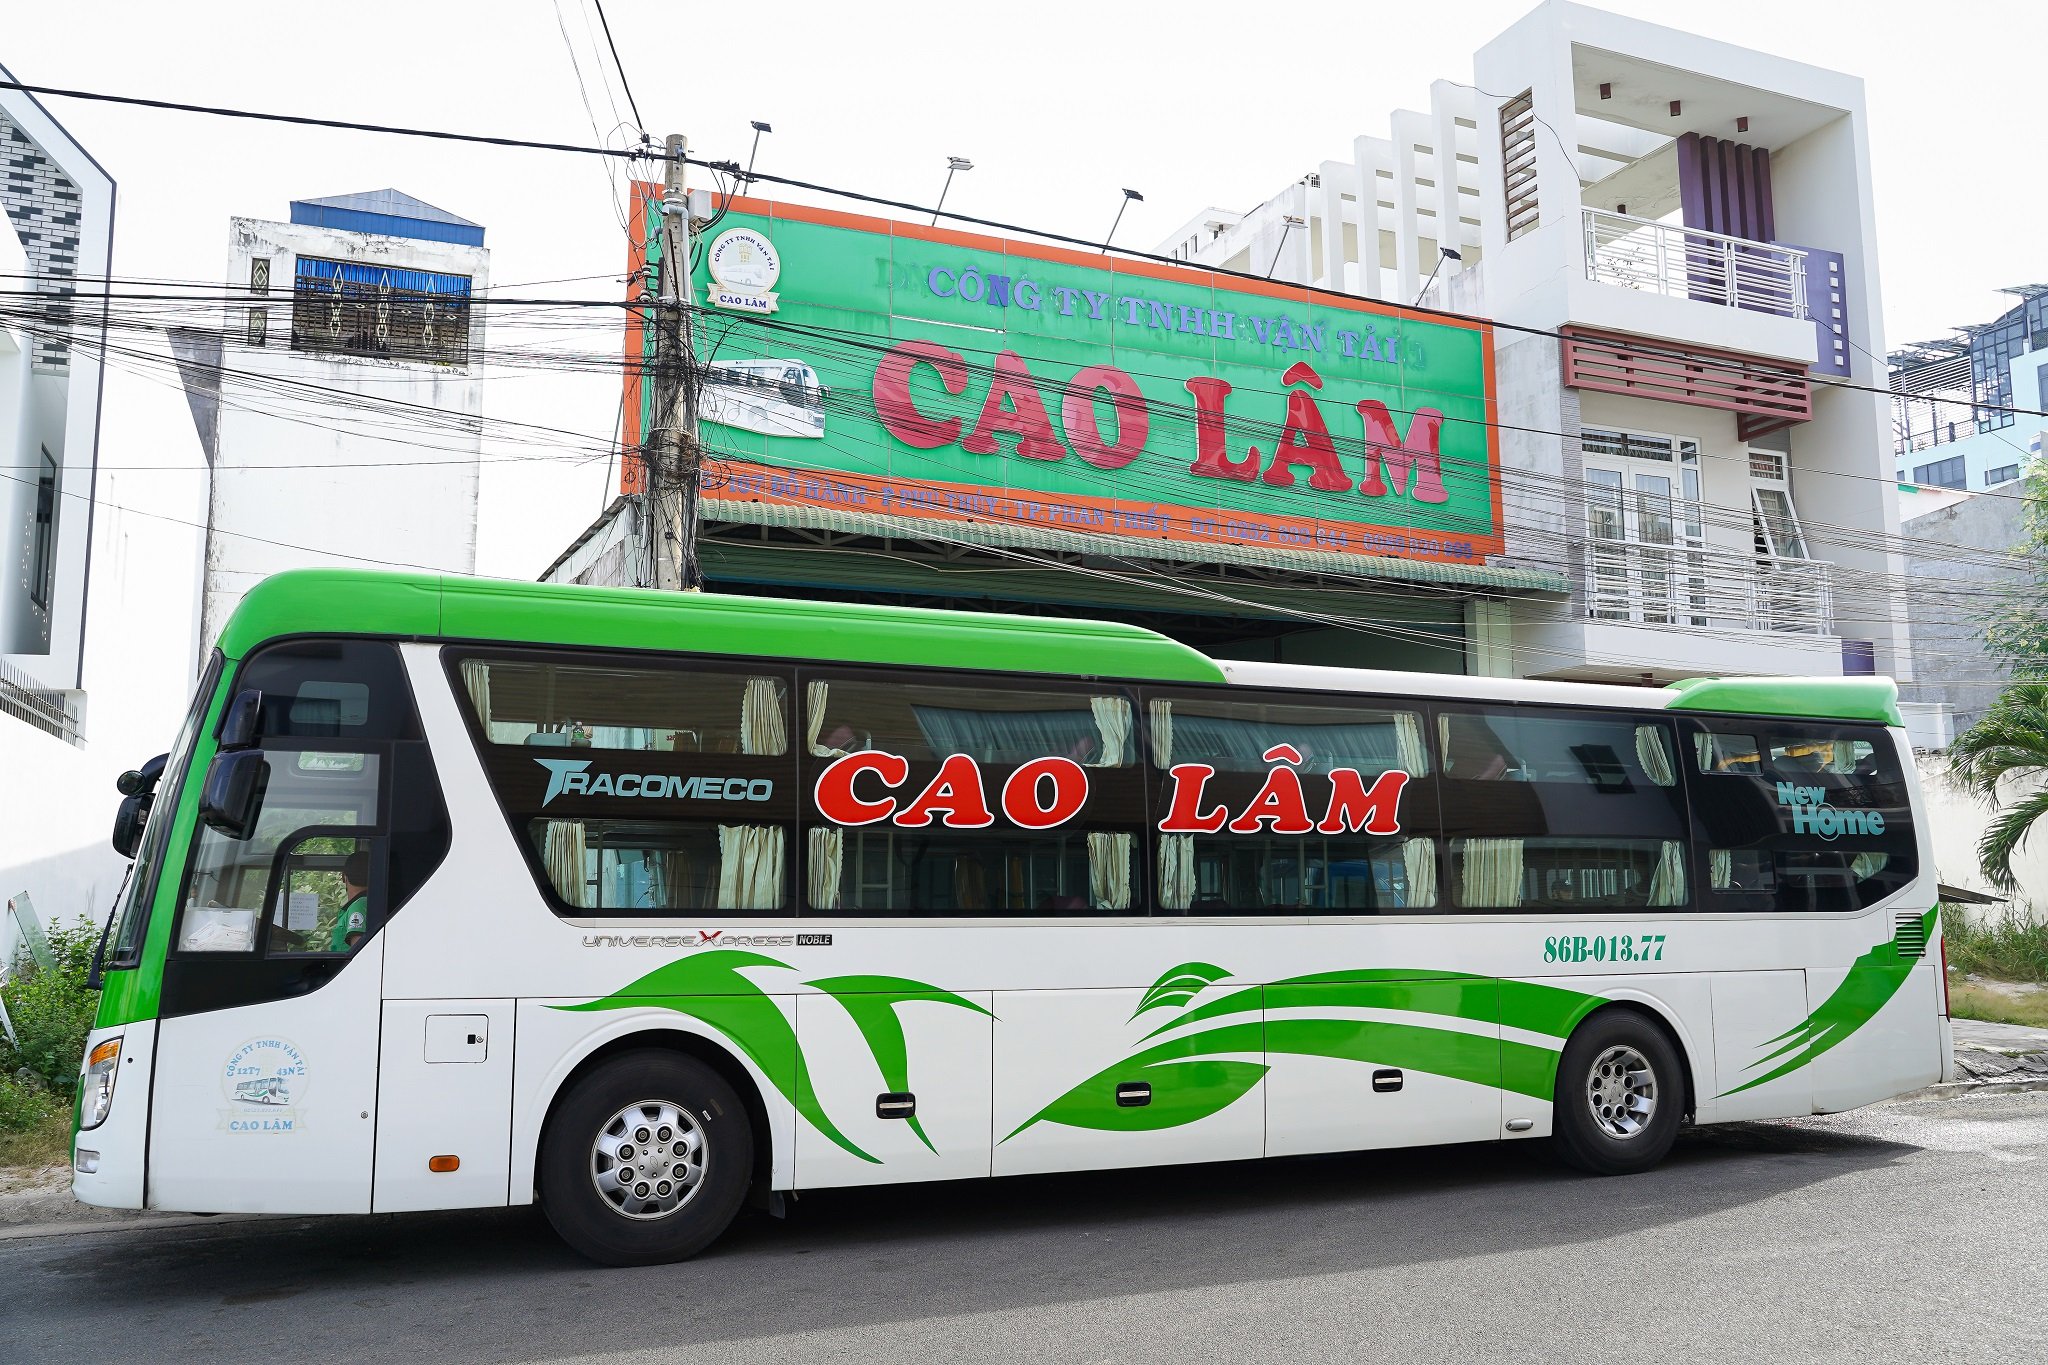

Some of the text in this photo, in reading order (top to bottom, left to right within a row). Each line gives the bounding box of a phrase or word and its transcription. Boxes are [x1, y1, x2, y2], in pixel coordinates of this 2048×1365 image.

[725, 238, 734, 246] TY
[735, 235, 756, 244] TNHH
[720, 294, 767, 308] CAO LÂM
[928, 264, 1041, 311] CÔNG
[1054, 286, 1110, 320] TY
[1120, 295, 1236, 340] TNHH
[1249, 314, 1322, 354] VẬN
[1336, 323, 1399, 364] TẢI
[872, 339, 1449, 503] CAO LÂM
[533, 758, 773, 808] TRACOMECO
[815, 743, 1409, 835] CAO LÂM
[1776, 781, 1826, 805] New
[1792, 803, 1885, 837] Home
[798, 934, 831, 946] NOBLE
[1543, 934, 1667, 963] 86B-013.77
[226, 1053, 243, 1077] CÔNG
[242, 1044, 254, 1055] TY
[256, 1040, 281, 1049] TNHH
[230, 1118, 293, 1131] CAO LÂM
